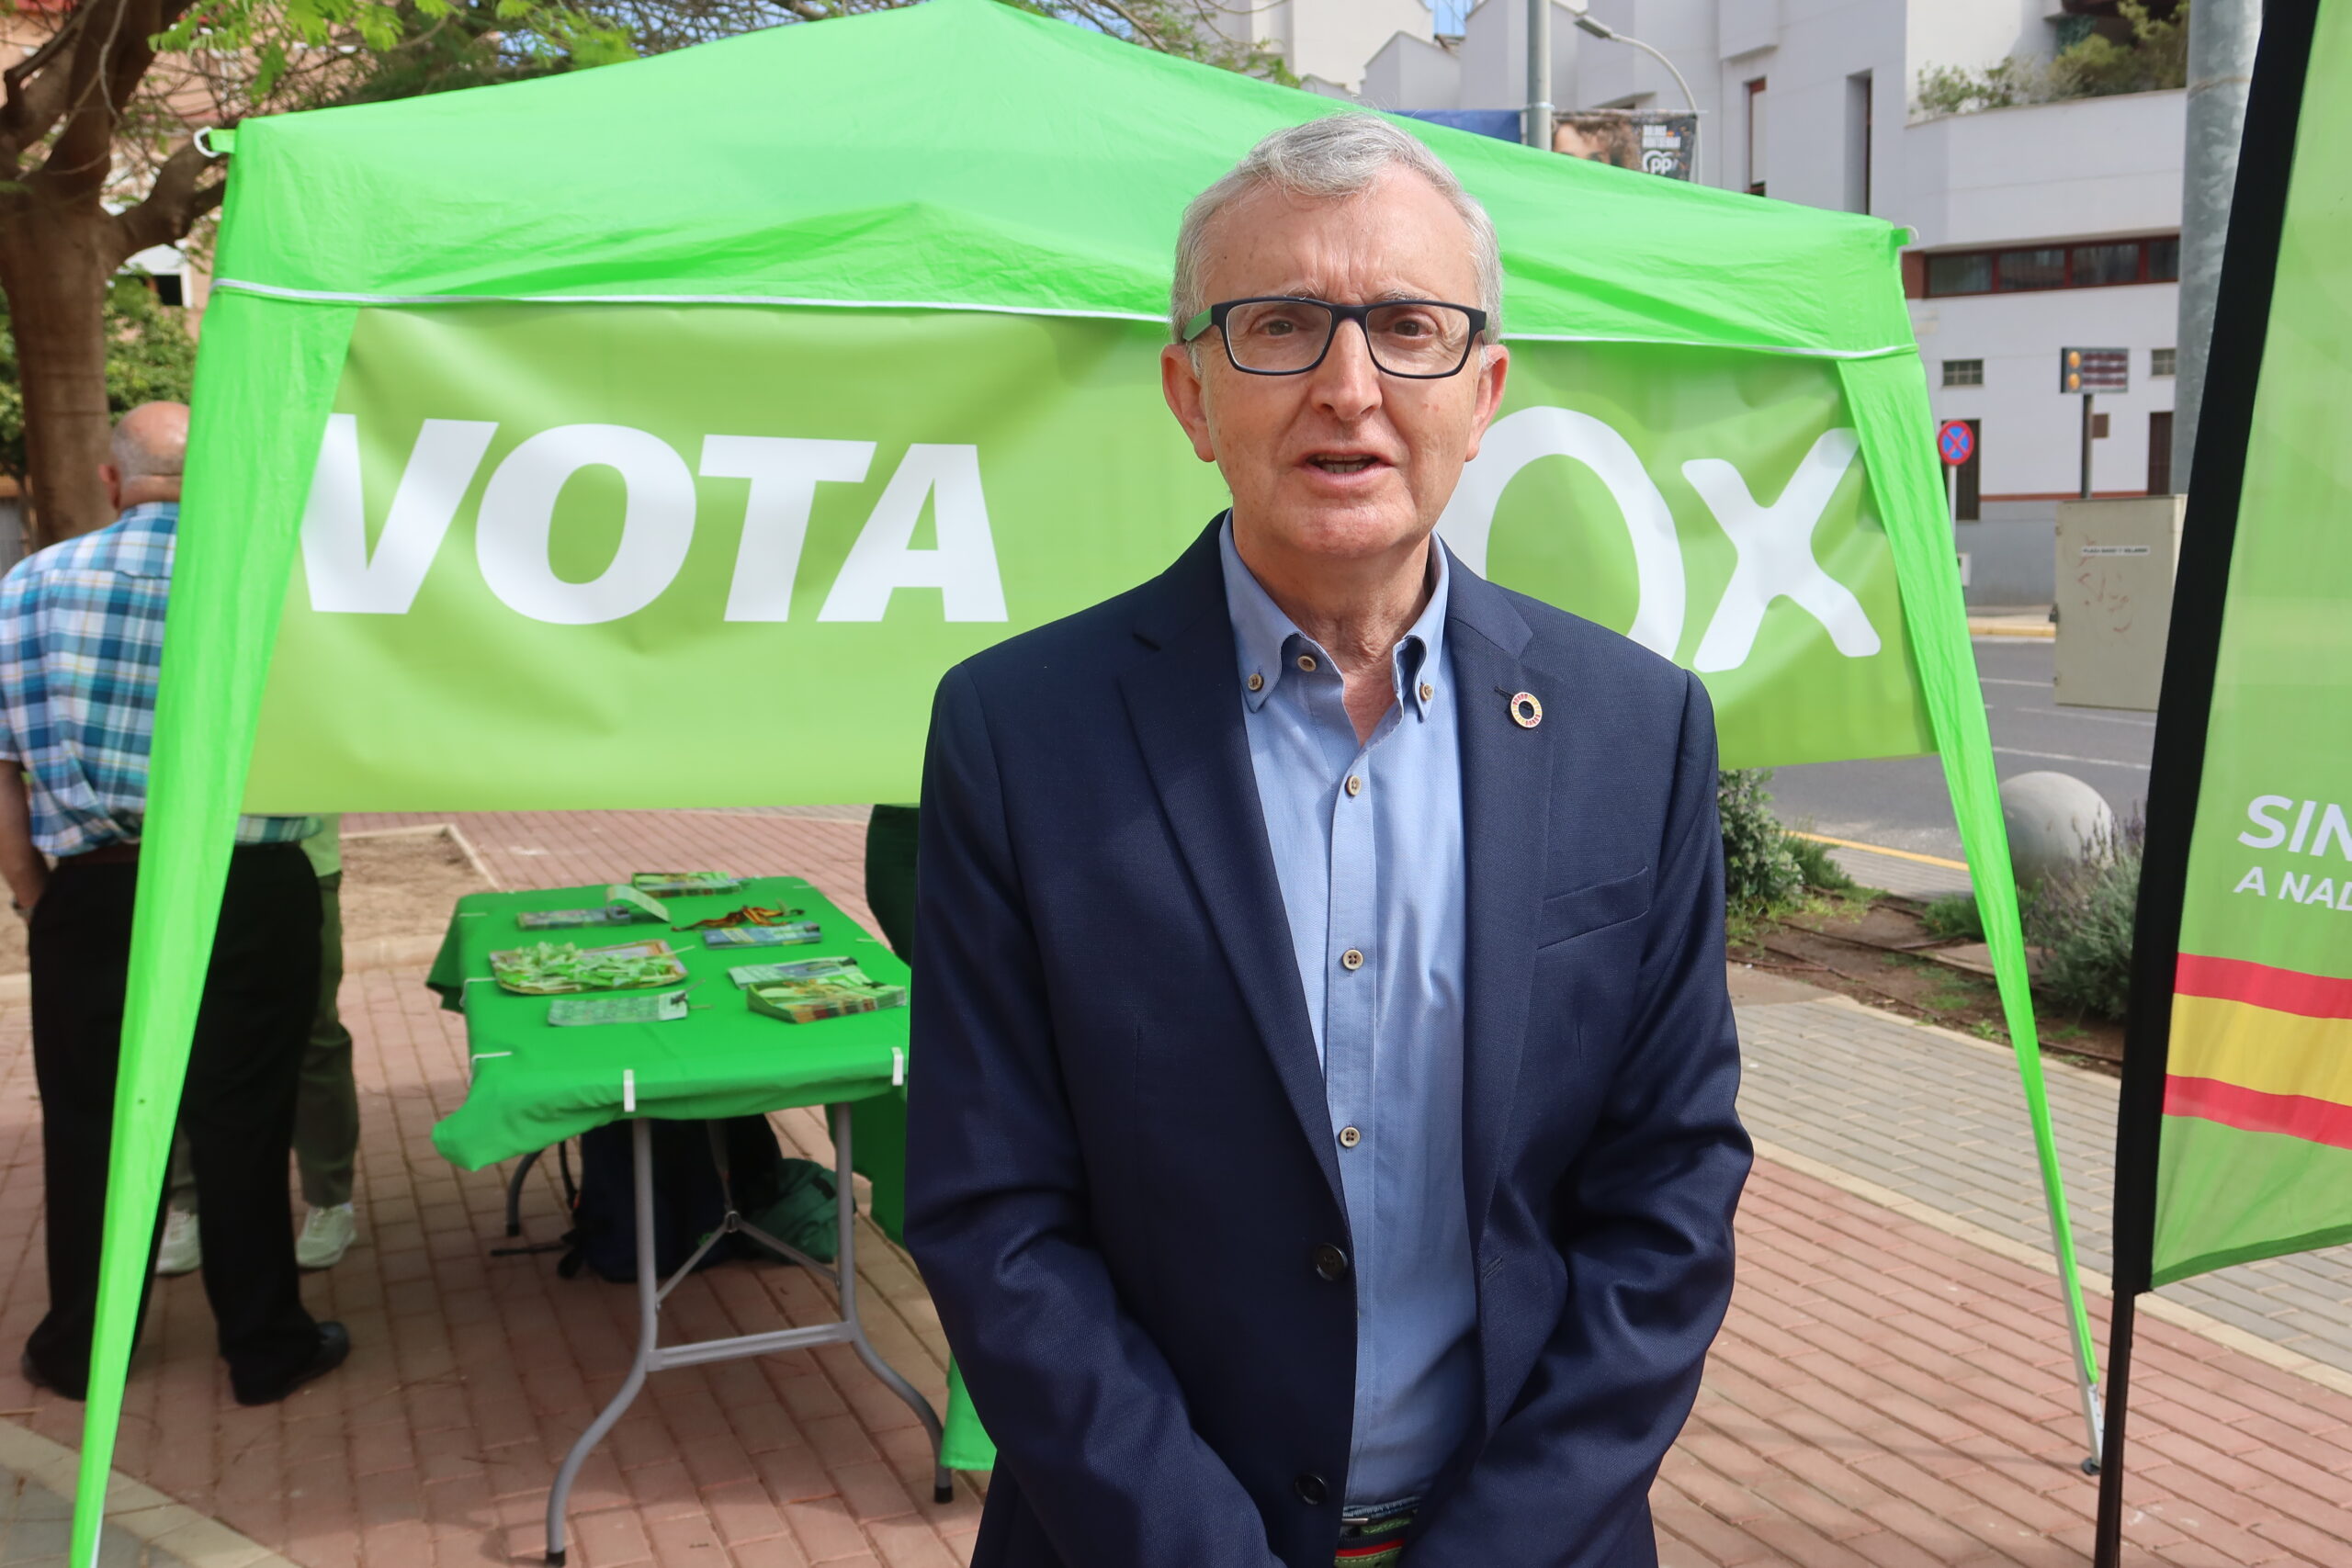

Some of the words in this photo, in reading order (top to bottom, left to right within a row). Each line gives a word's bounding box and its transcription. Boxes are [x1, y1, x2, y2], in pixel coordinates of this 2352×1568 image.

[300, 412, 1009, 625] VOTA
[1431, 405, 1882, 673] OX
[2237, 795, 2352, 862] SIN
[2233, 866, 2267, 897] A
